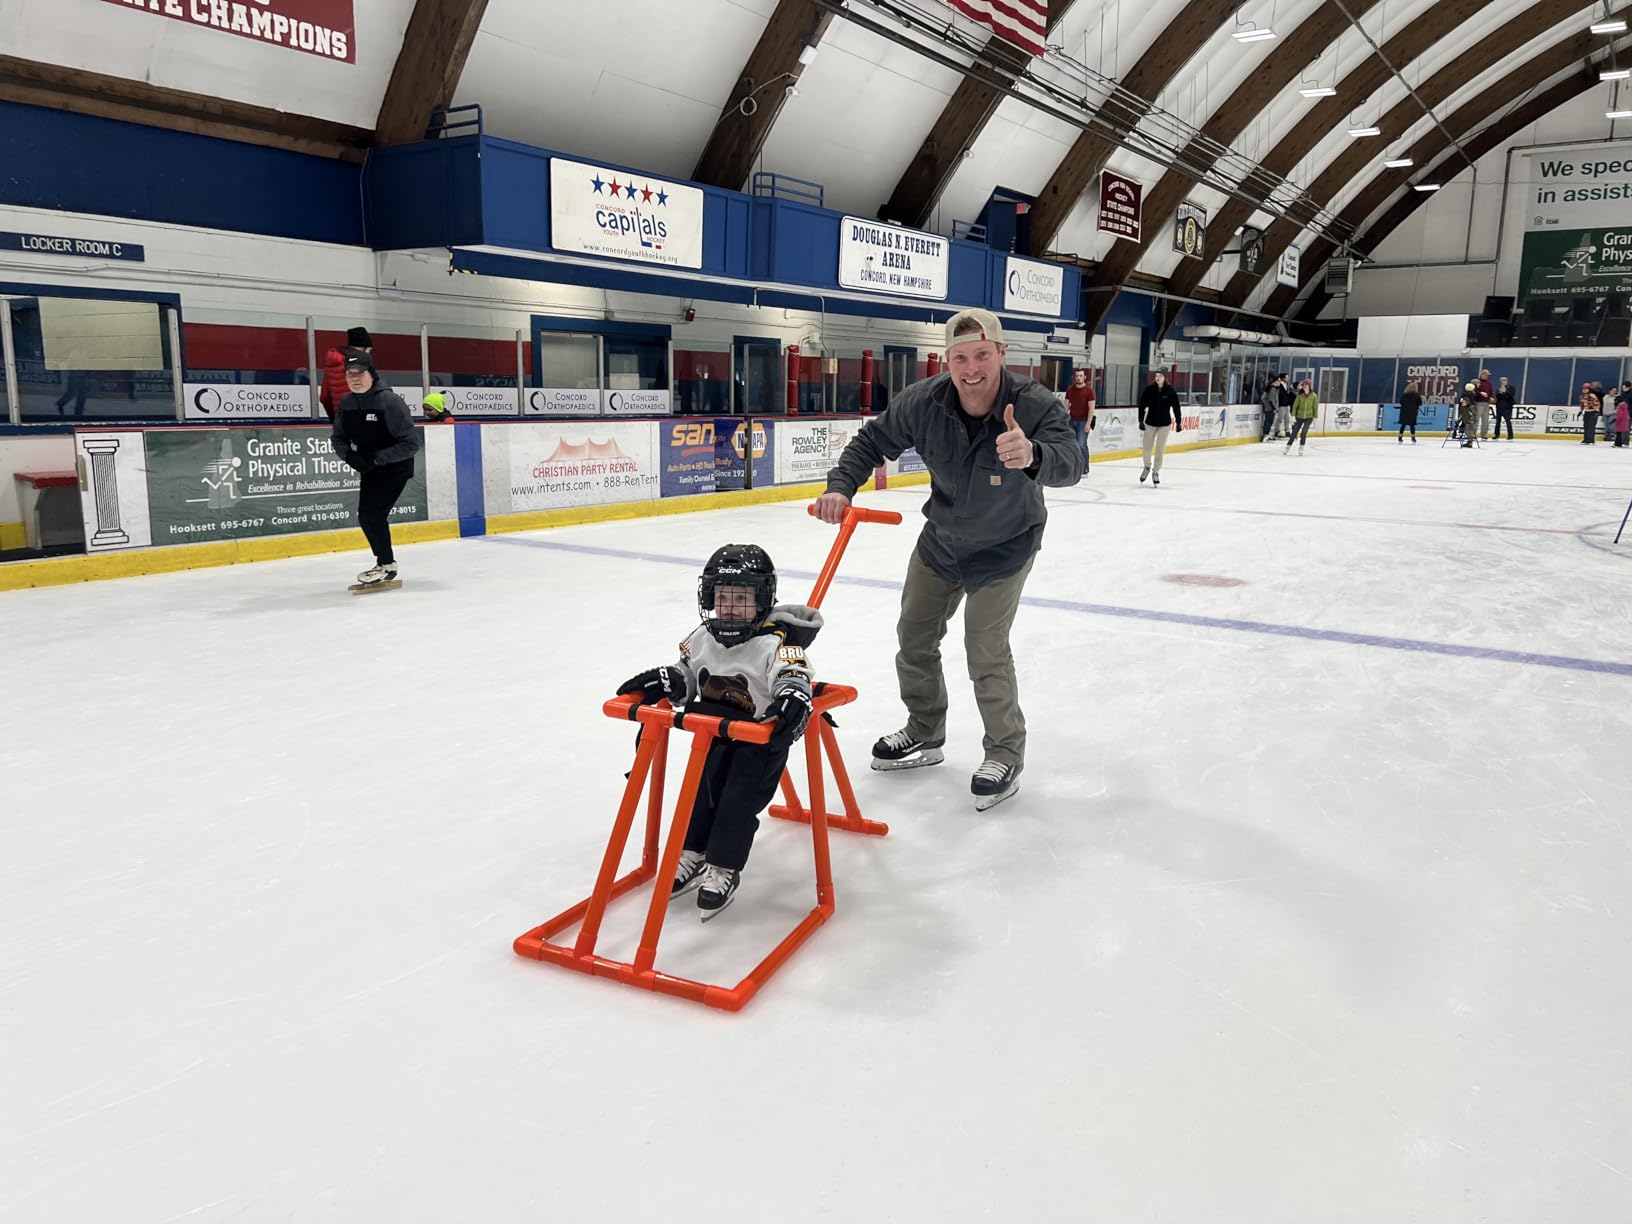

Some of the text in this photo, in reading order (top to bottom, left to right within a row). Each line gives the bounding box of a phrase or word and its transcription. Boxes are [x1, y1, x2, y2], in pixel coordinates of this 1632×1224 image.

[190, 0, 348, 59] CHAMPIONS
[1540, 160, 1574, 178] We
[1537, 183, 1632, 204] in assist
[595, 203, 626, 214] CONCORD
[21, 236, 122, 256] LOCKER ROOM C
[852, 225, 941, 257] DOUGLAS N. EVERETT
[882, 251, 911, 270] ARENA
[889, 274, 901, 286] NEW
[903, 275, 932, 290] HAMPSHIRE
[1530, 287, 1568, 295] Hooksett
[1407, 365, 1459, 377] CONCORD
[811, 427, 827, 436] THE
[247, 437, 337, 457] Granite Stat
[791, 435, 827, 446] ROWLEY
[793, 444, 827, 455] AGENCY
[248, 457, 306, 481] Physical
[715, 457, 732, 466] Body
[532, 462, 638, 479] CHRISTIAN PARTY RENTAL
[679, 475, 694, 484] Family
[694, 474, 710, 482] Owned
[714, 469, 732, 477] Since
[247, 484, 284, 493] Excellence
[286, 482, 294, 491] in
[295, 479, 340, 490] Rehabilitation
[511, 474, 658, 496] www.intents.com 888-RenTent
[276, 502, 344, 514] Three great locations
[169, 522, 216, 534] Hooksett
[220, 518, 264, 530] 695-6767
[271, 514, 308, 525] Concord
[311, 510, 350, 522] 410-6309
